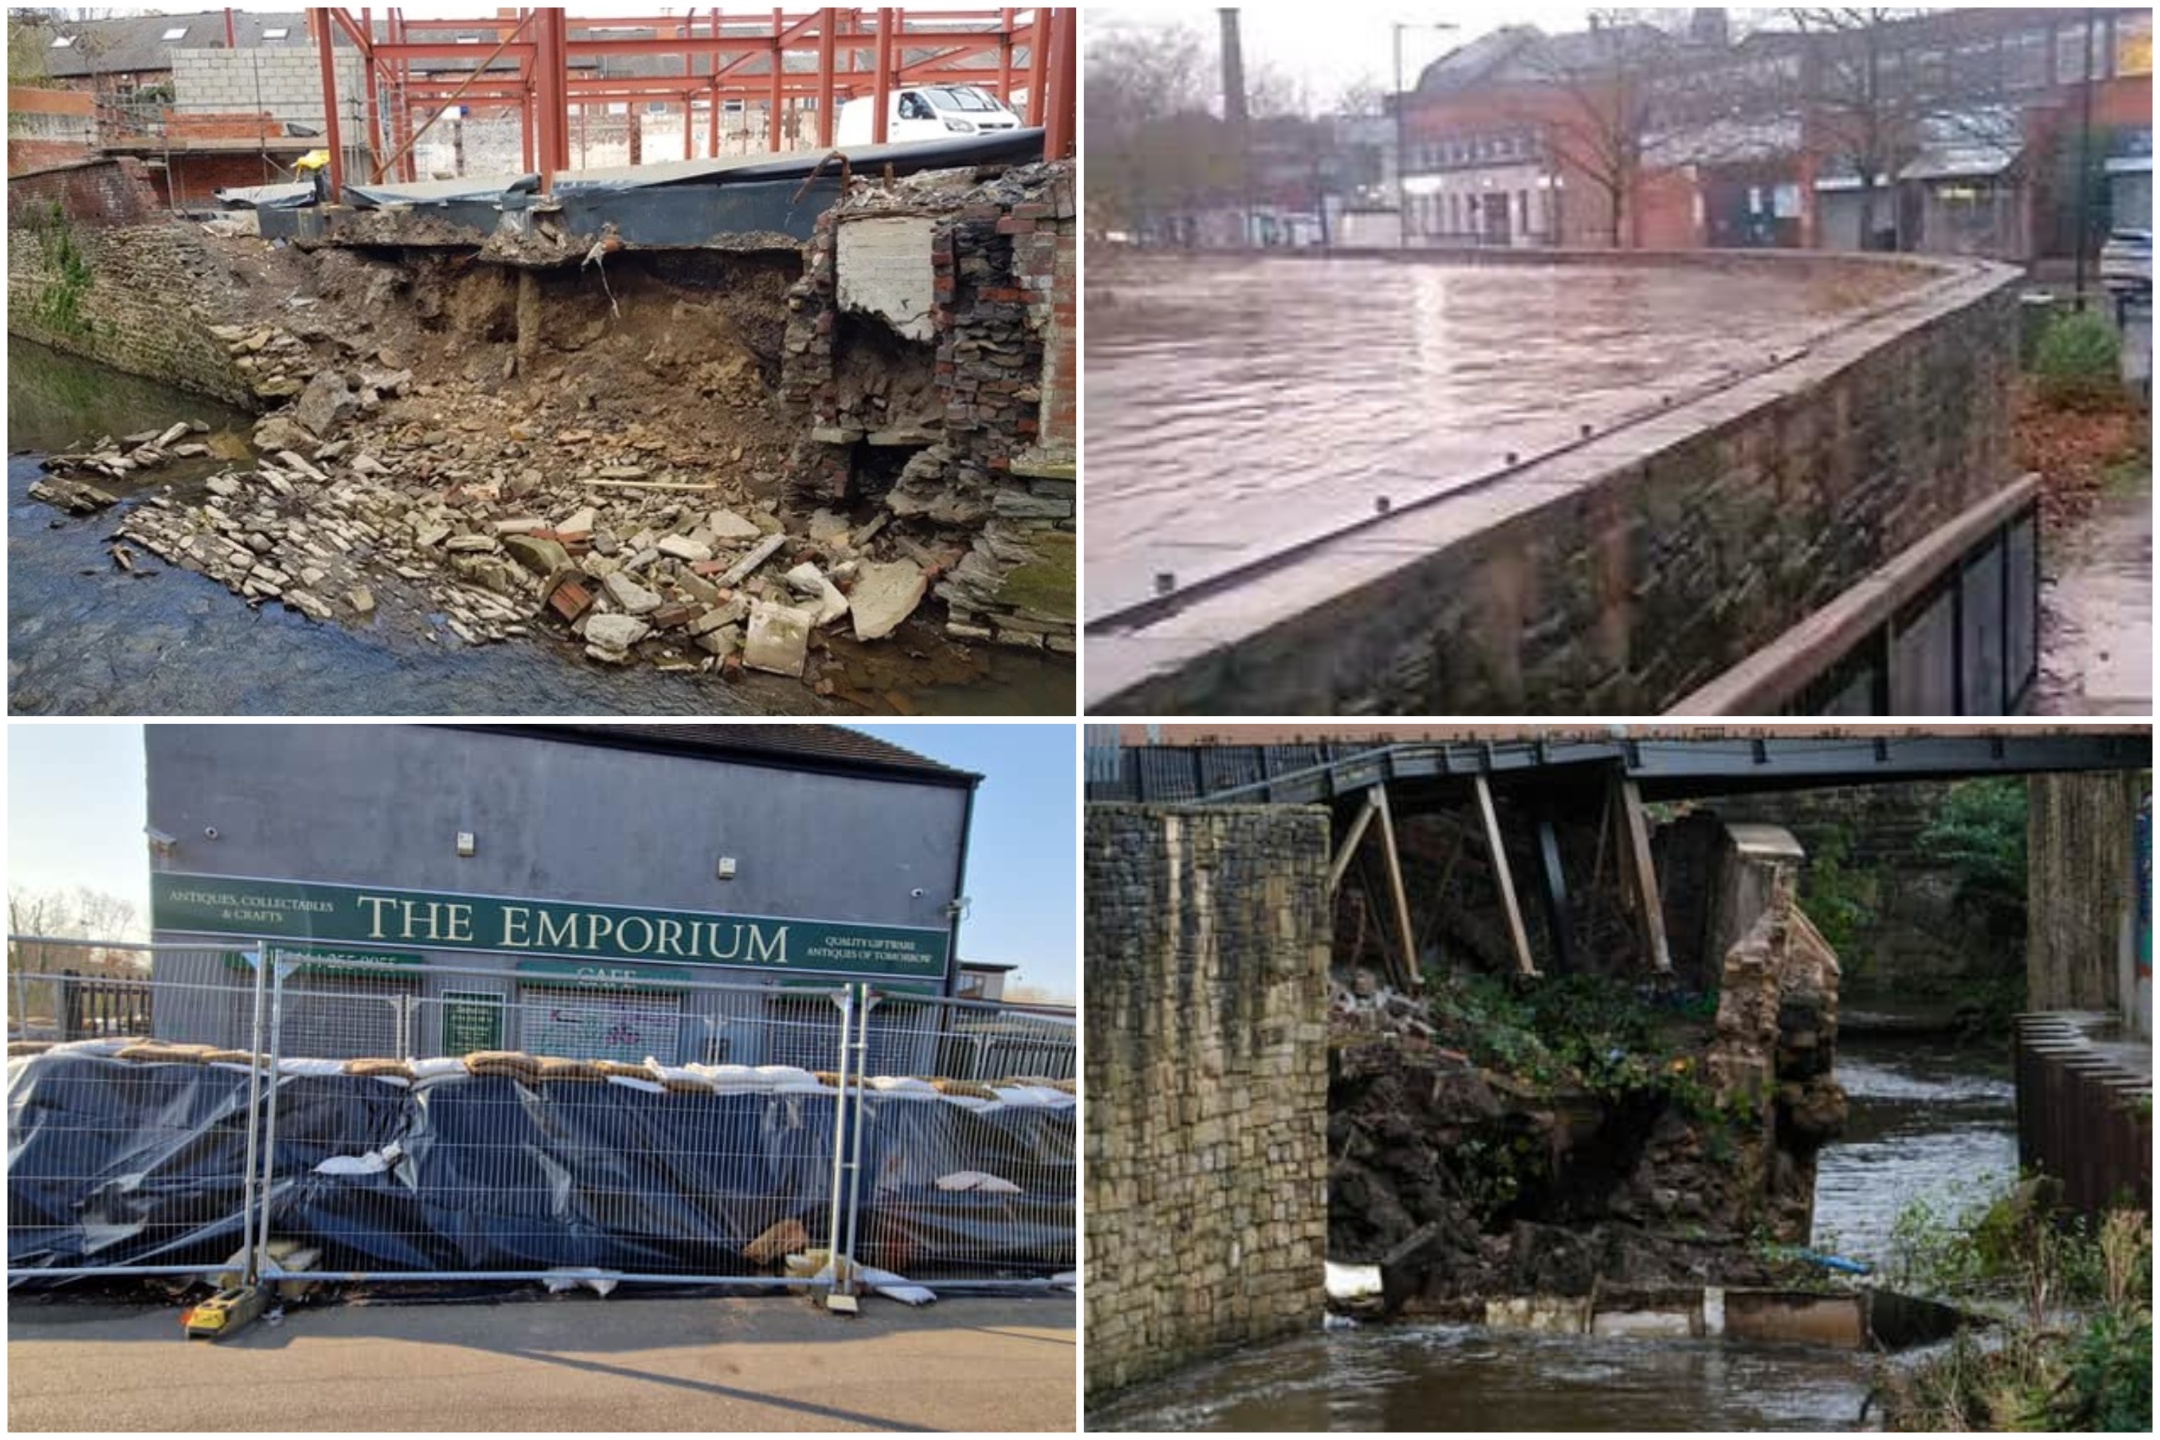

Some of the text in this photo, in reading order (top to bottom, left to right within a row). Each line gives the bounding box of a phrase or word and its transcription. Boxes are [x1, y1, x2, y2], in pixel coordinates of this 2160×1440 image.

[242, 895, 334, 912] COLLECTABLES
[221, 909, 283, 922] & CRAFTS
[357, 896, 790, 963] THE EMPORIUM
[825, 936, 868, 948] QUALITY
[807, 947, 933, 963] ANTIQUES OF TOMORROW
